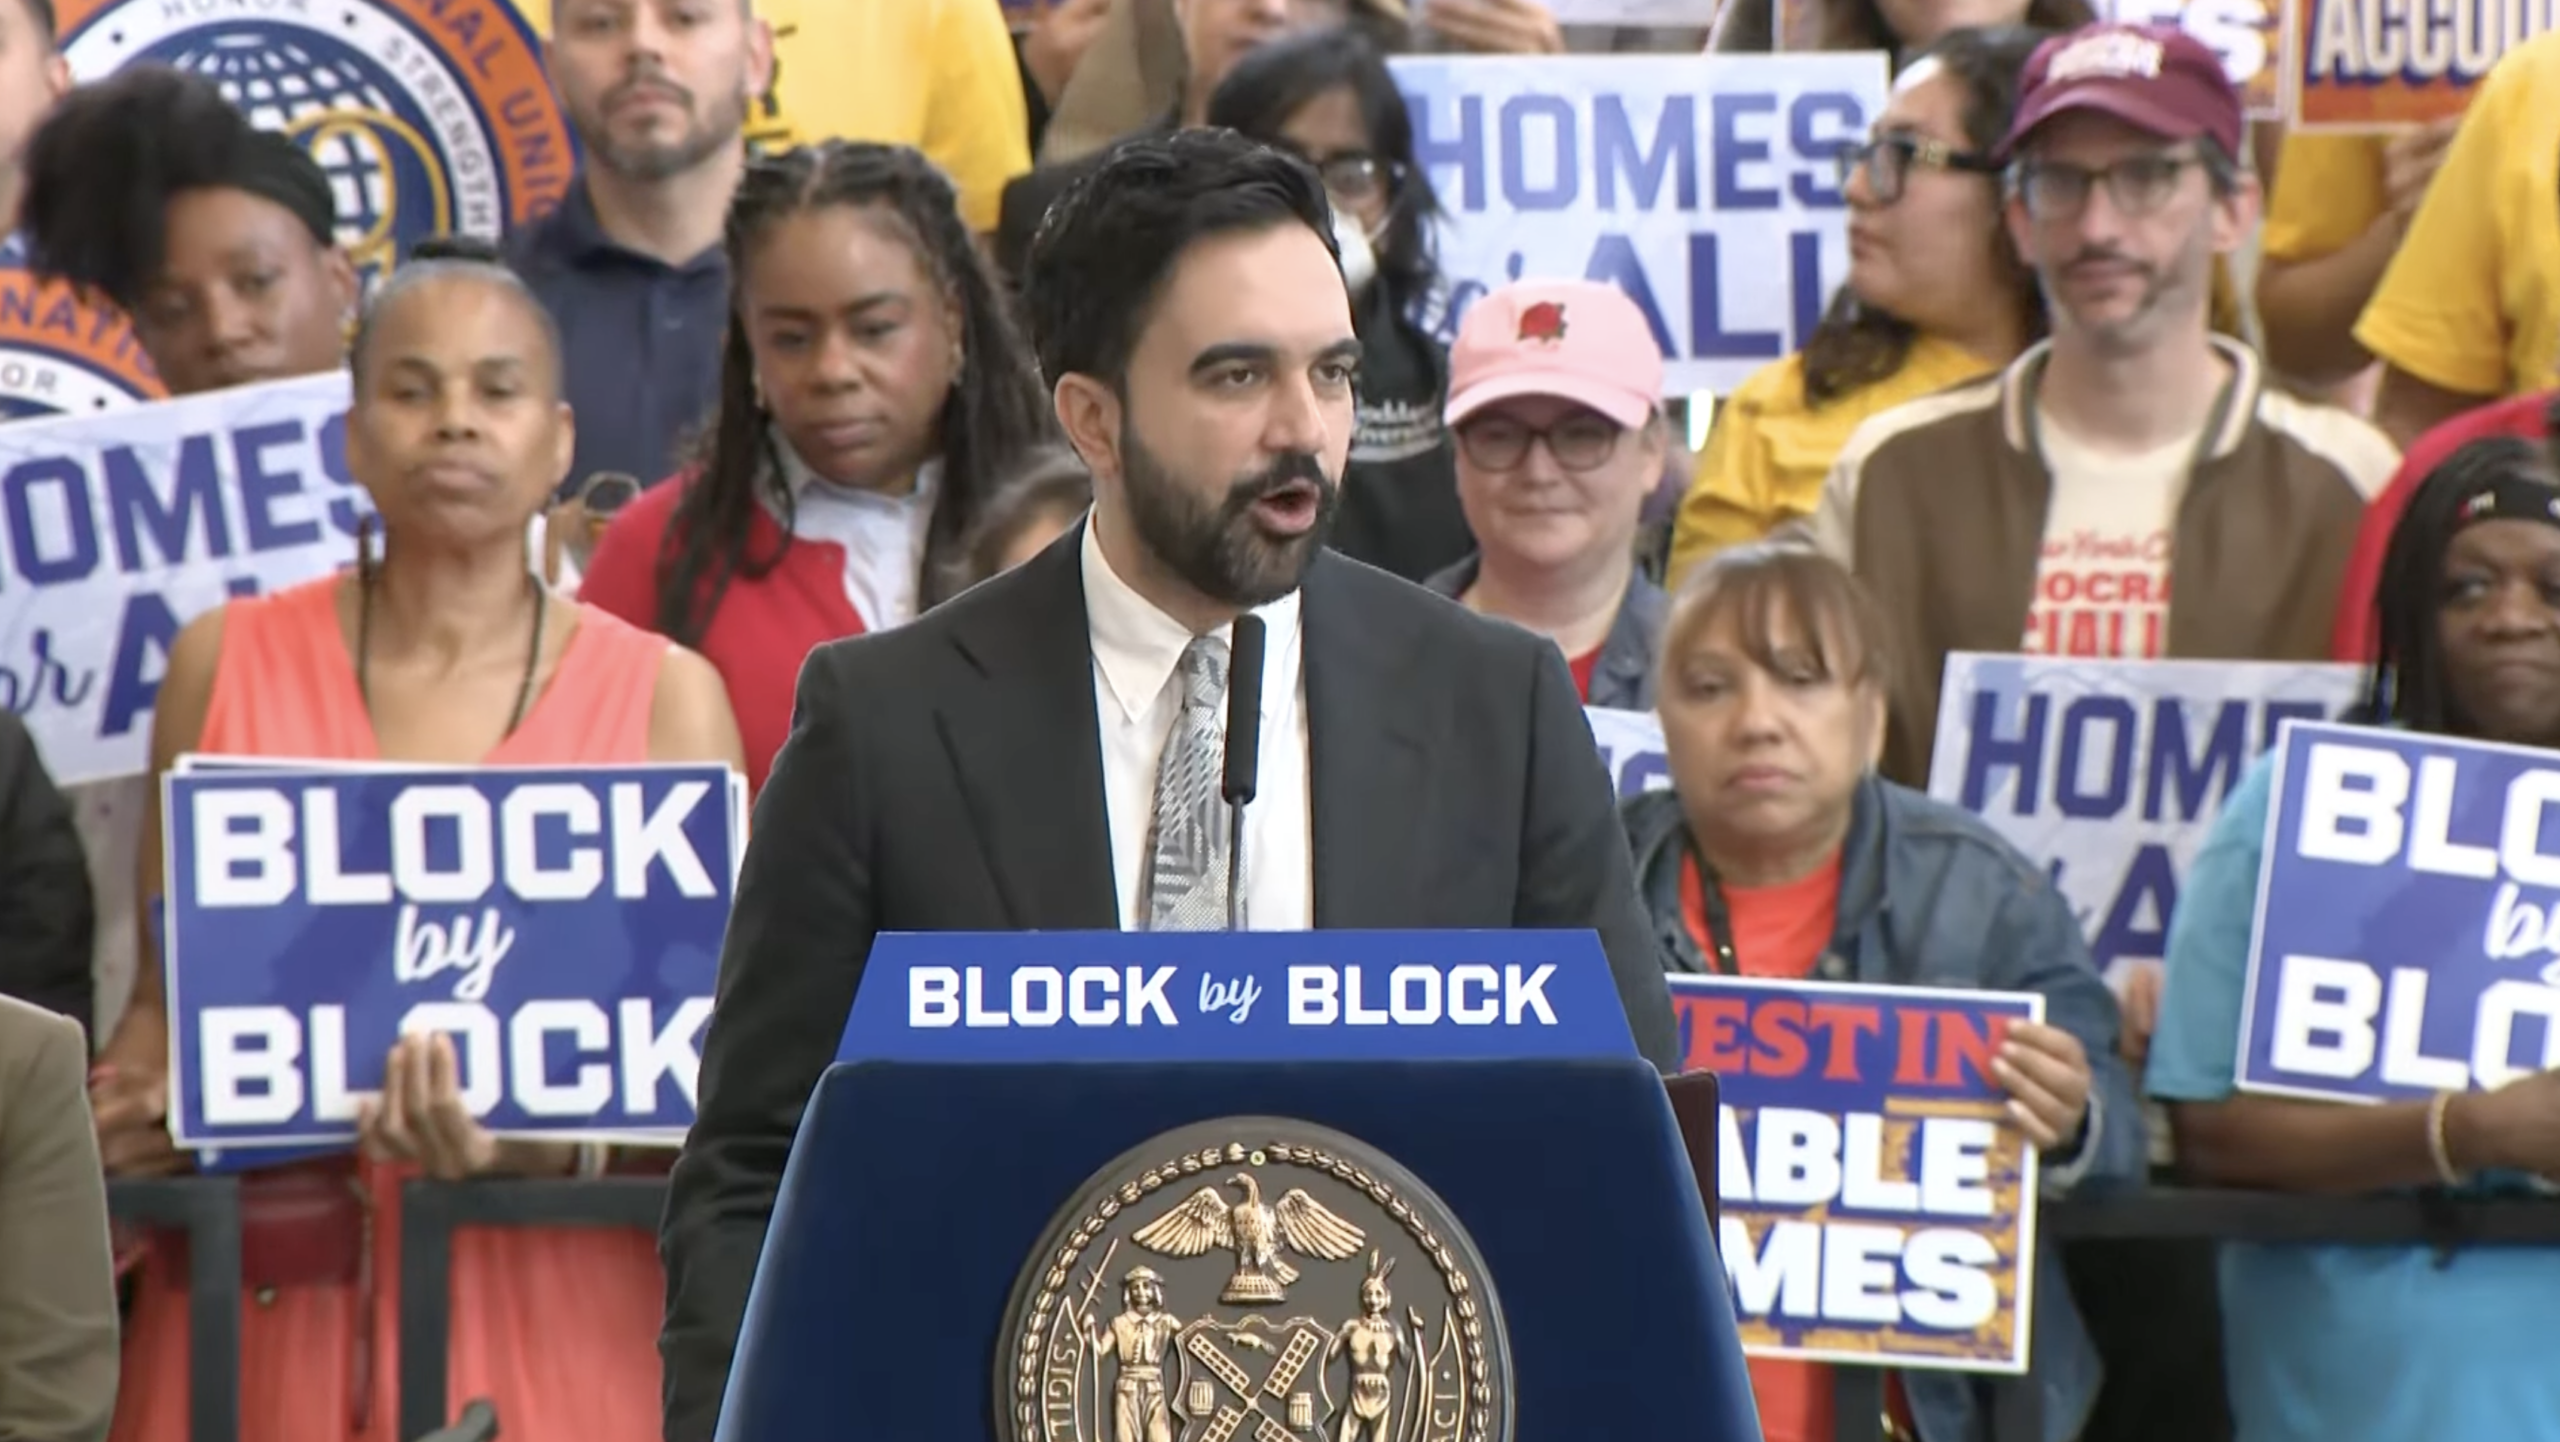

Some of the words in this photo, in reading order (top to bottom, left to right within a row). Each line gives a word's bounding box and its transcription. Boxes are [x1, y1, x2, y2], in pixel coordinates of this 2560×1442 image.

[382, 36, 492, 226] STRENGTH
[1407, 92, 1864, 212] HOMES
[193, 780, 718, 907] BLOCK
[393, 903, 515, 1001] by
[908, 965, 1179, 1028] BLOCK
[1198, 970, 1261, 1023] by
[1287, 963, 1558, 1026] BLOCK
[198, 996, 718, 1126] BLOCK
[2270, 954, 2560, 1092] BLO
